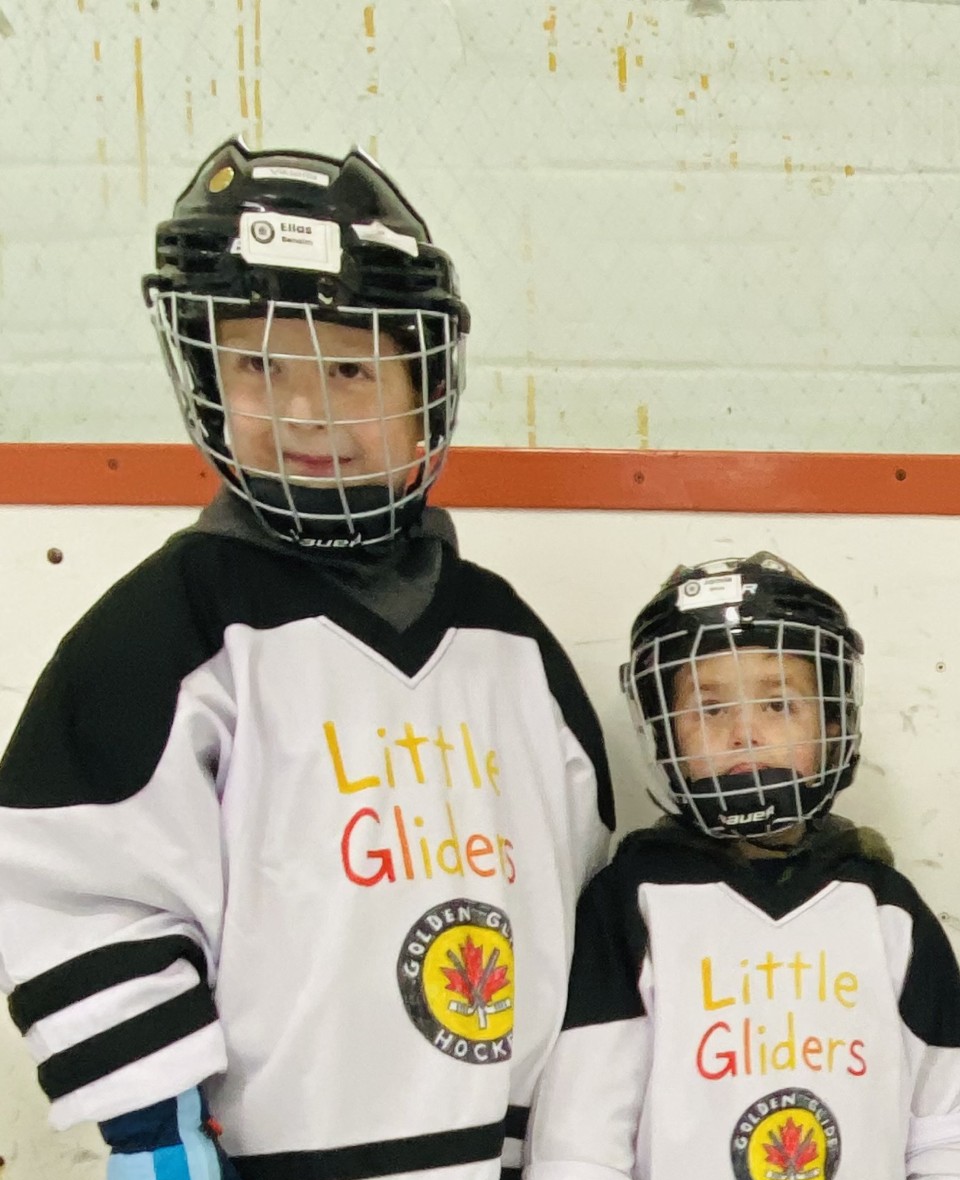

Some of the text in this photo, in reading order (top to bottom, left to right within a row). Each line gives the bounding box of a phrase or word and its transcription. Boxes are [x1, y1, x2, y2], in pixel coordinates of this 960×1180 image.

[323, 720, 500, 797] Little
[403, 906, 472, 978] GOLDEN
[701, 950, 859, 1011] Little
[696, 1011, 867, 1081] Gliders
[735, 1093, 839, 1149] GOLDEN GLIDE
